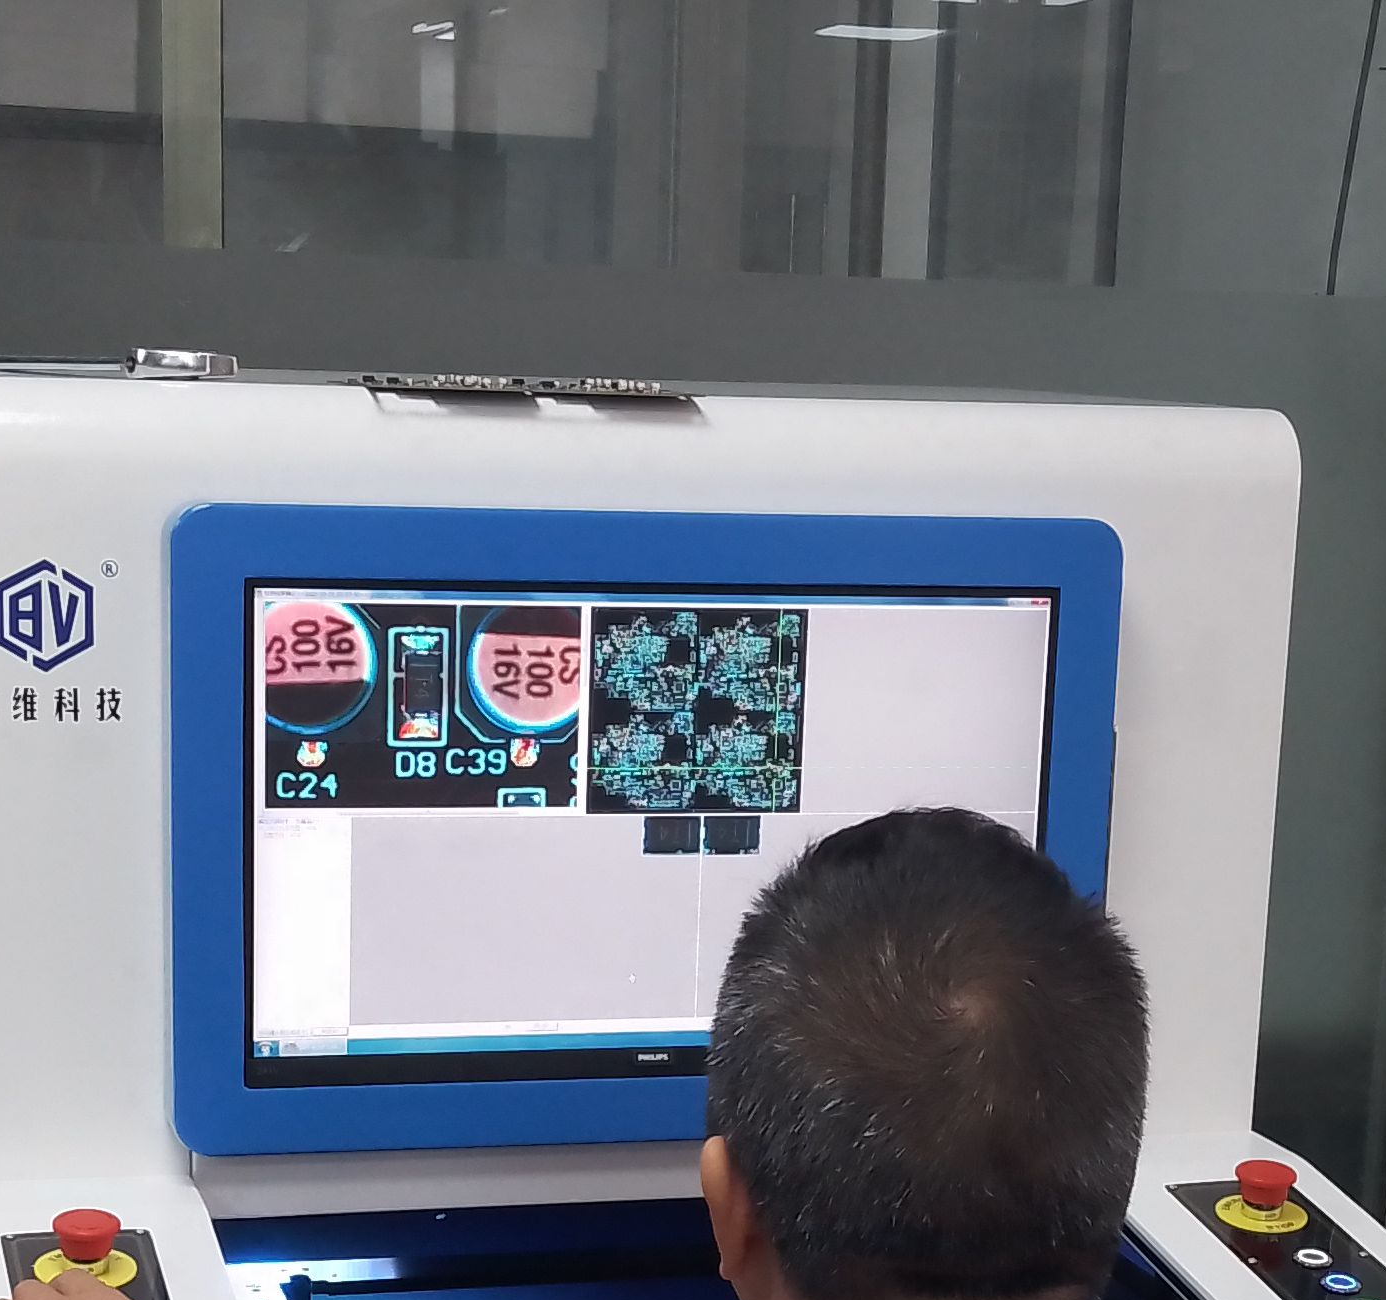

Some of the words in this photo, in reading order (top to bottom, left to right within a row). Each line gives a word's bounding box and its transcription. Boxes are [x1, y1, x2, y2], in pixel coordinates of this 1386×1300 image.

[291, 619, 320, 672] 100
[325, 615, 356, 673] 16V
[493, 644, 521, 700] 16V
[526, 646, 554, 699] 100
[276, 772, 338, 798] C24
[396, 751, 436, 777] D8
[446, 748, 507, 774] C39
